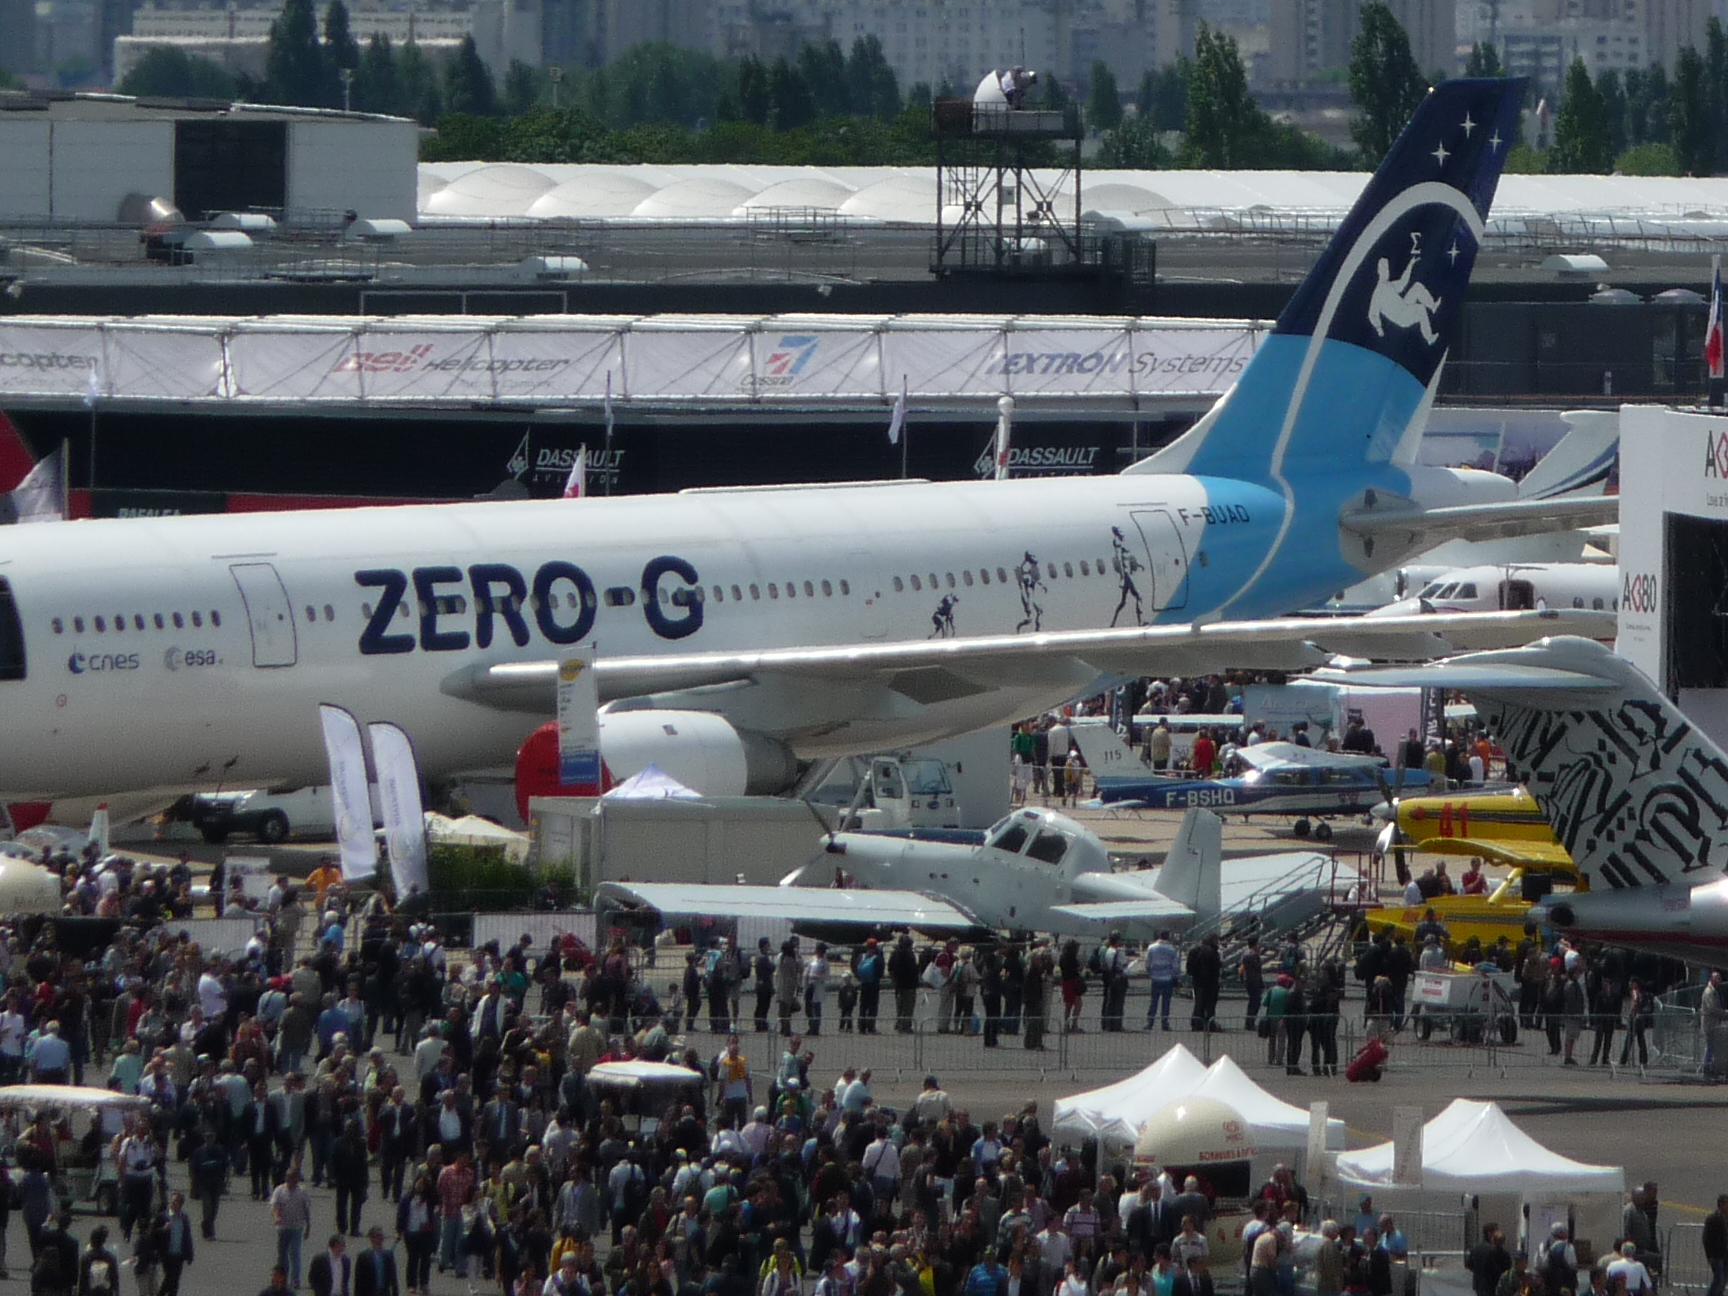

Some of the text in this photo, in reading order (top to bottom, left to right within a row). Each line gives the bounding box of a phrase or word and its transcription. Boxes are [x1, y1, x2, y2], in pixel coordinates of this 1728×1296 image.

[422, 357, 570, 376] Helicopter
[985, 352, 1249, 378] TEXTRON Systems
[1008, 447, 1100, 465] DASSAULT
[1177, 504, 1250, 527] F-BUAD
[354, 554, 705, 655] ZERO-G
[89, 653, 140, 671] cnes
[185, 649, 215, 666] esa
[1439, 802, 1470, 838] 41
